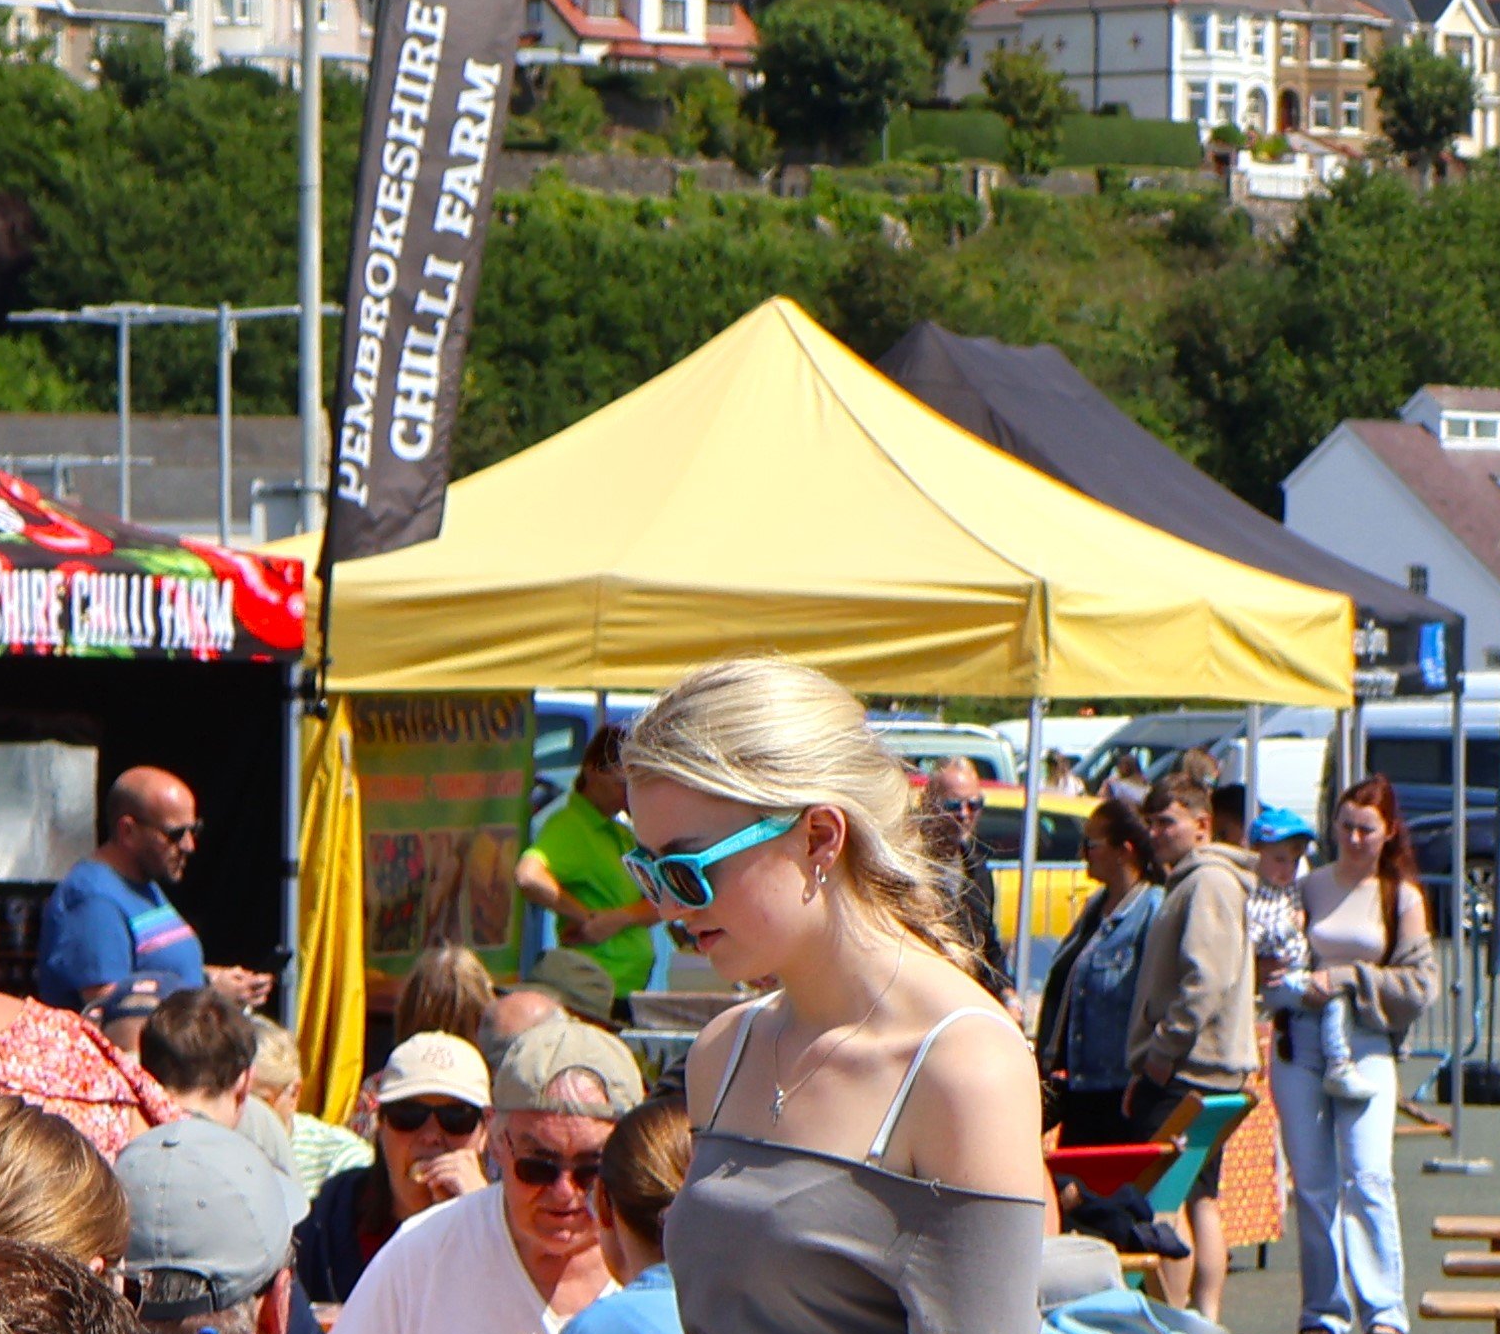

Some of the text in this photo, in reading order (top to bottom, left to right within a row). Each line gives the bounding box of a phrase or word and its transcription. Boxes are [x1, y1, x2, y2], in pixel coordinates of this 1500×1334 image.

[338, 0, 447, 507] PEMBROKESHIRE
[389, 59, 502, 461] CHILLI FARM
[70, 573, 156, 646] CHILLI
[158, 576, 236, 651] FARM
